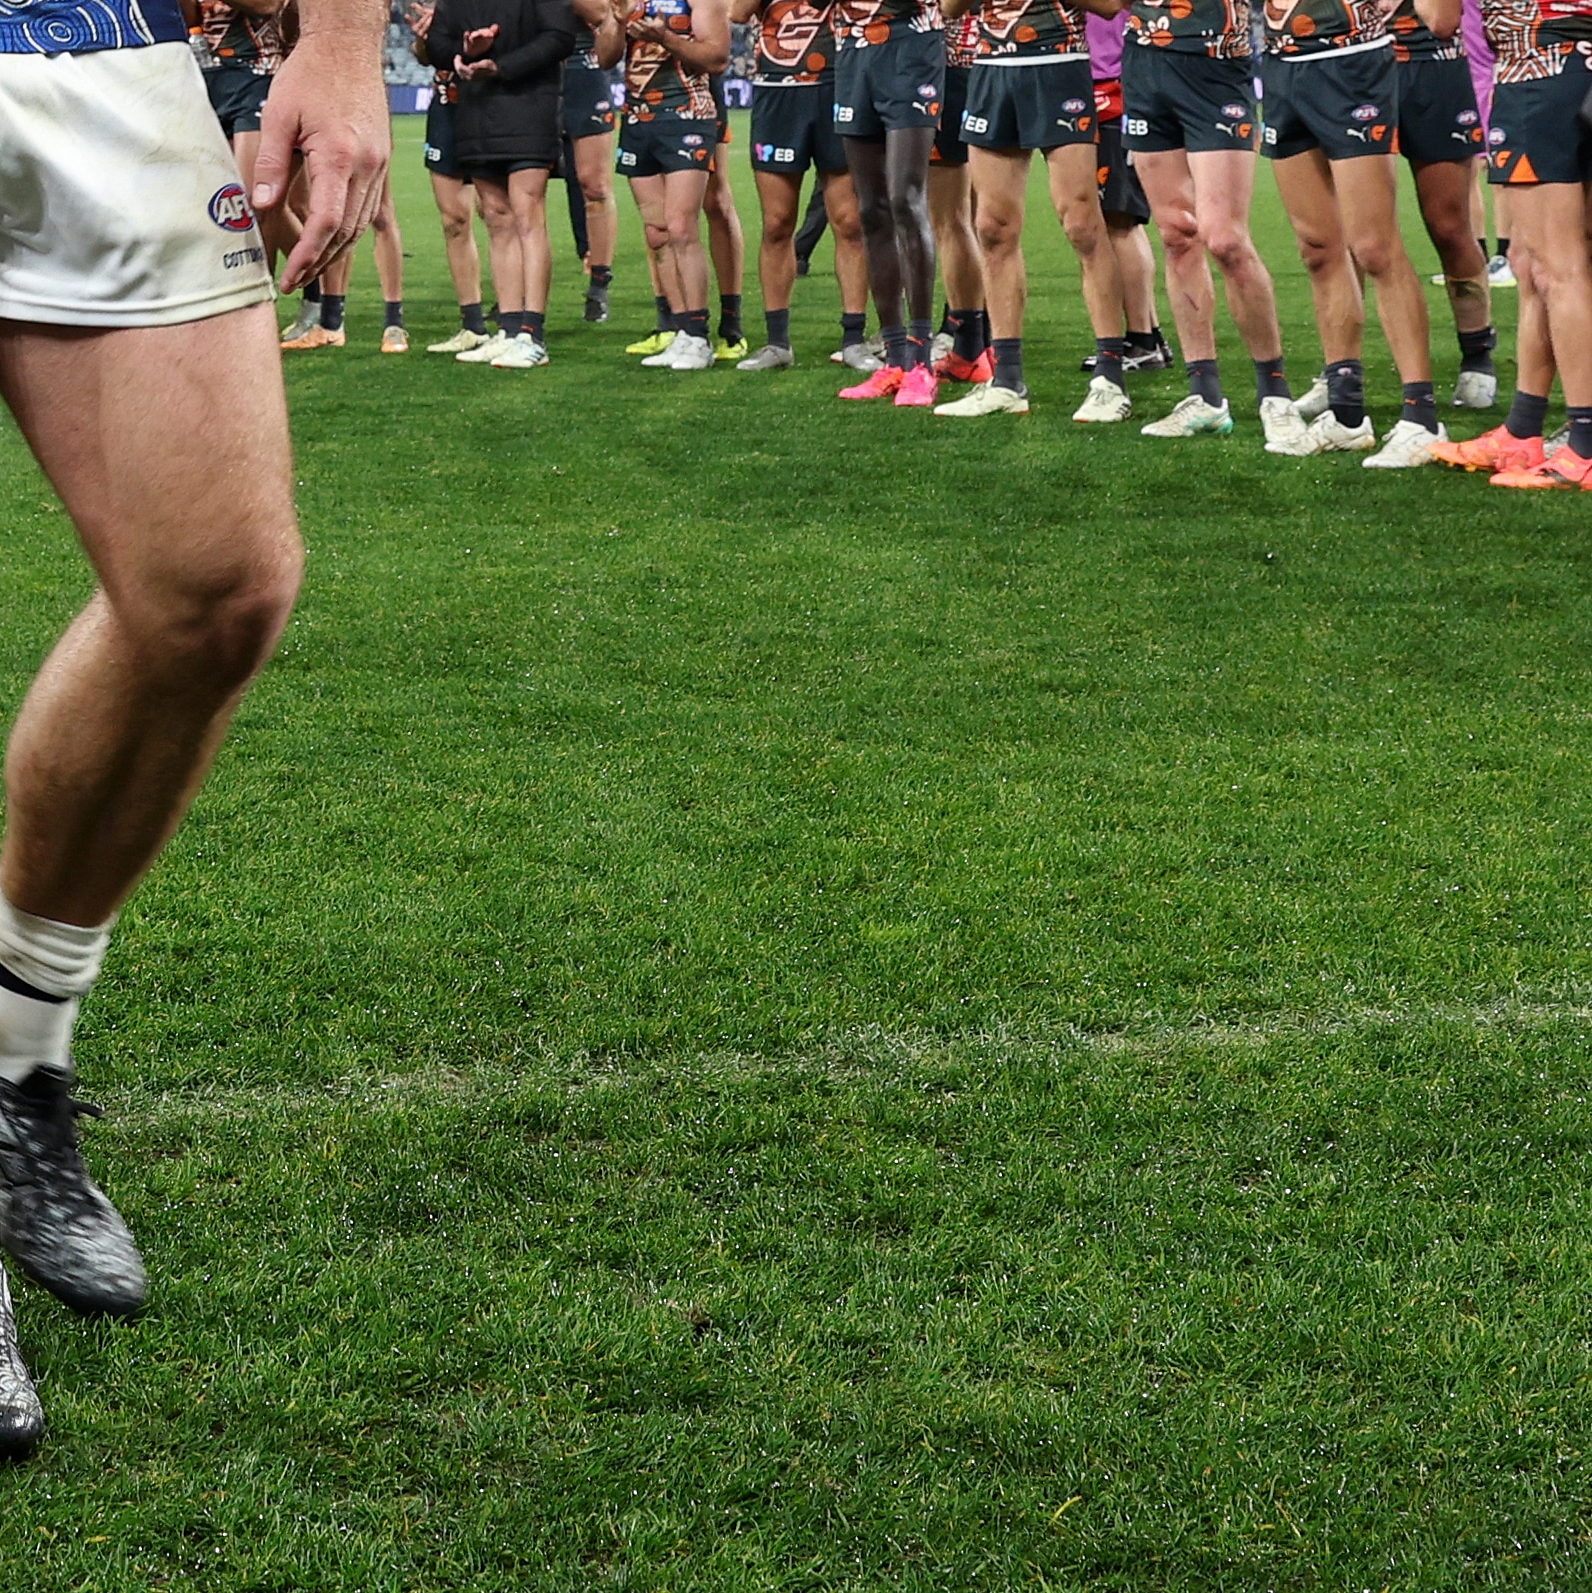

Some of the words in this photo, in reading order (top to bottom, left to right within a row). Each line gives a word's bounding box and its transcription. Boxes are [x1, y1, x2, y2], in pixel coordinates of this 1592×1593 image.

[839, 107, 854, 122] EB
[965, 115, 989, 134] EB
[1127, 119, 1149, 137] EB
[428, 148, 441, 162] EB
[621, 152, 637, 167] EB
[774, 148, 795, 162] EB
